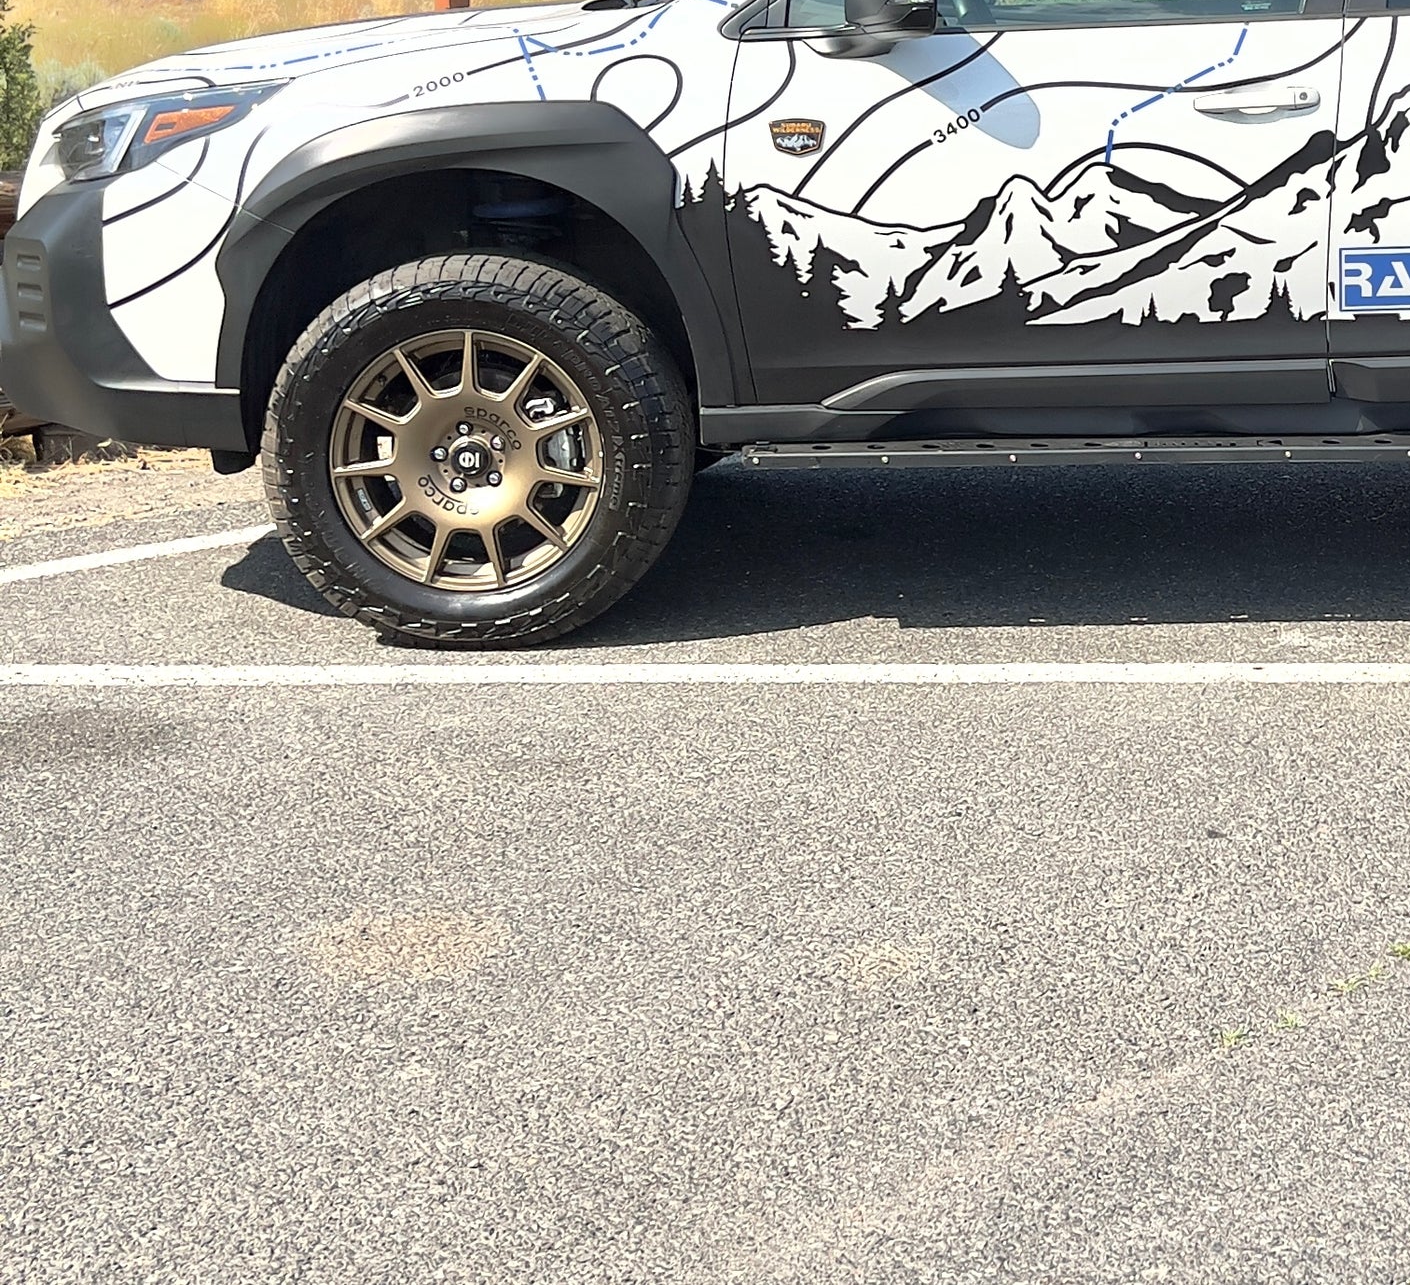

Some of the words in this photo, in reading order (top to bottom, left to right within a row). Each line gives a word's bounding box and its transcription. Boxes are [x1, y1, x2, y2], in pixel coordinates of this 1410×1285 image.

[413, 72, 464, 97] 2000
[933, 108, 980, 143] 3400
[463, 406, 522, 450] sparco
